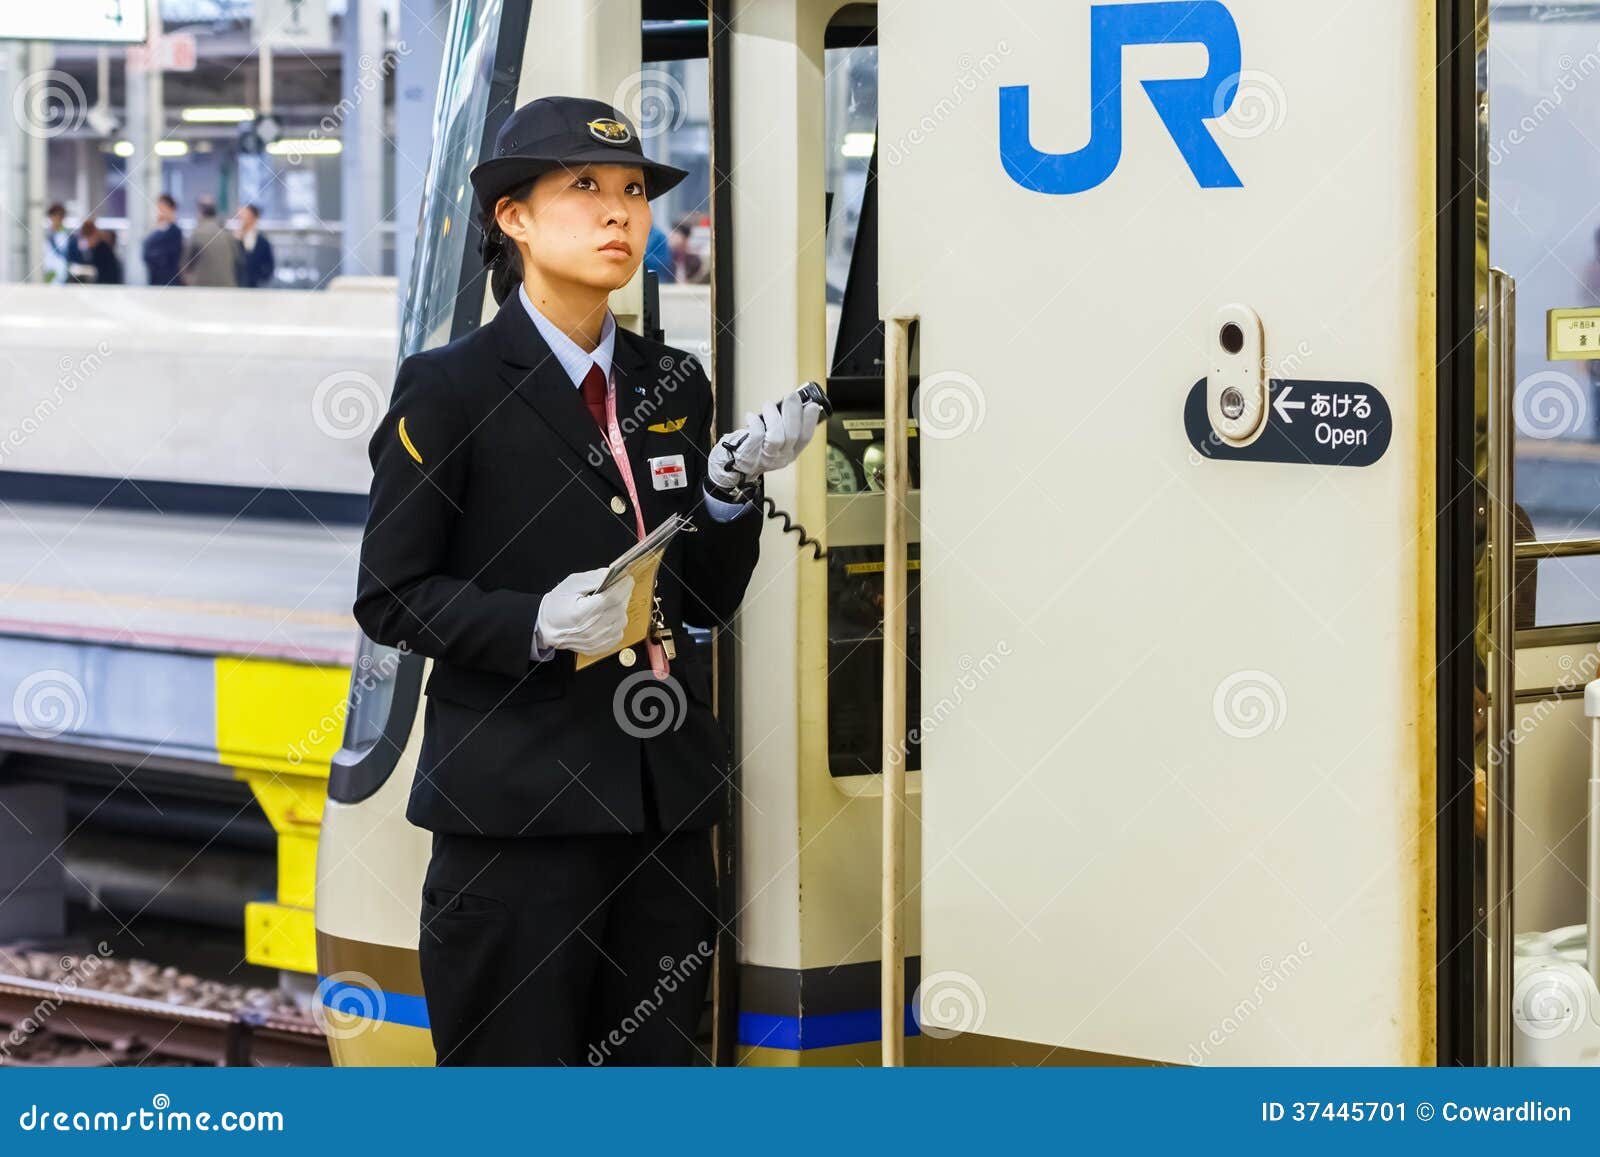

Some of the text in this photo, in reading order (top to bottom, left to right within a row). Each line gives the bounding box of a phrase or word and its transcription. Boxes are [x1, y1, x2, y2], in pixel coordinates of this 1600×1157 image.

[999, 0, 1244, 195] JR
[1310, 392, 1372, 419] あける
[1314, 422, 1368, 450] Open
